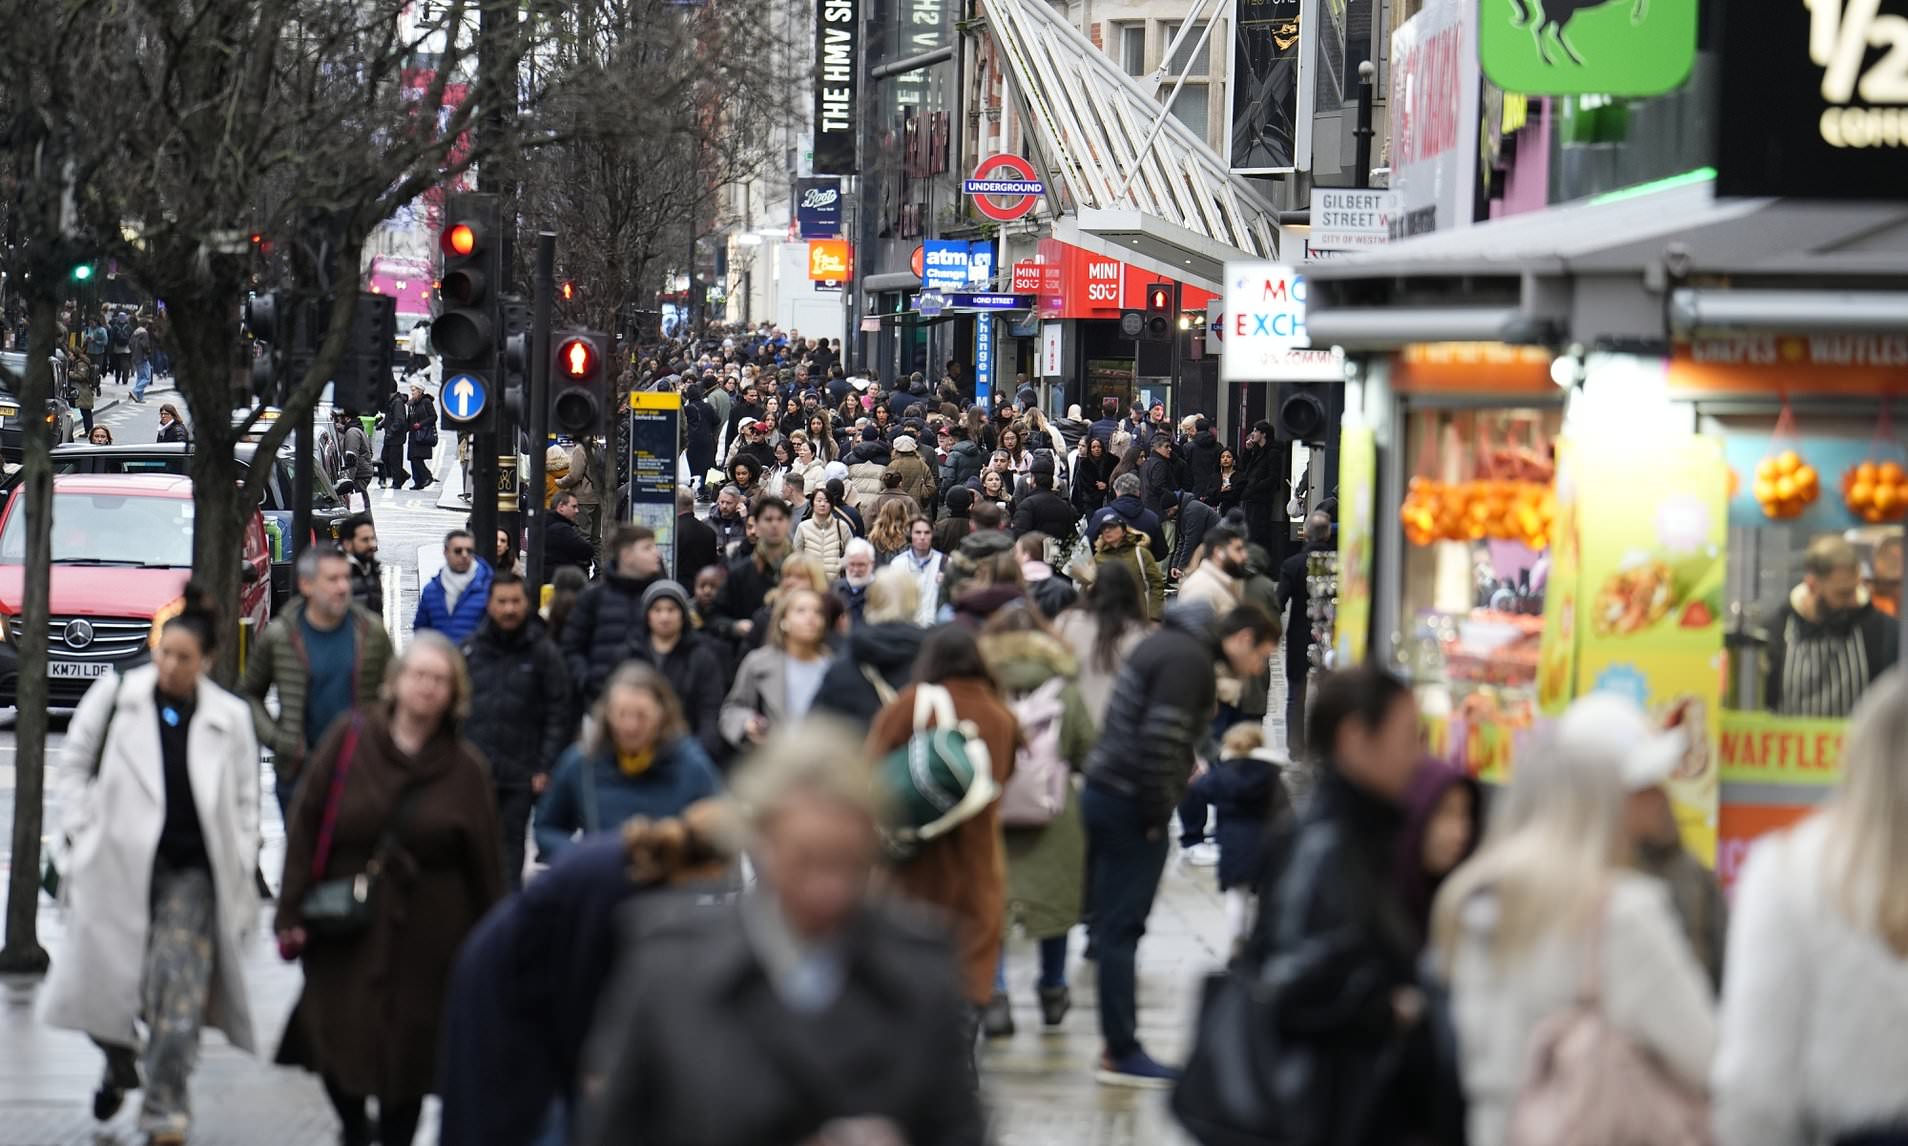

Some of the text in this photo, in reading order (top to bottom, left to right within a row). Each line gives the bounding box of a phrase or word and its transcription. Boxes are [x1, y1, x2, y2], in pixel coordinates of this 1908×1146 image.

[822, 0, 852, 133] THE HMV S
[968, 182, 1042, 192] UNDERGROUND
[1323, 194, 1381, 209] GILBERT
[1322, 211, 1374, 227] STREET
[1322, 235, 1340, 244] CITY
[1342, 235, 1352, 244] OF
[926, 249, 968, 266] atm
[926, 268, 967, 280] Change
[1016, 268, 1040, 278] MINI
[1089, 264, 1117, 279] MINI
[928, 279, 963, 289] Money
[979, 312, 989, 371] Change
[52, 664, 80, 676] KM71
